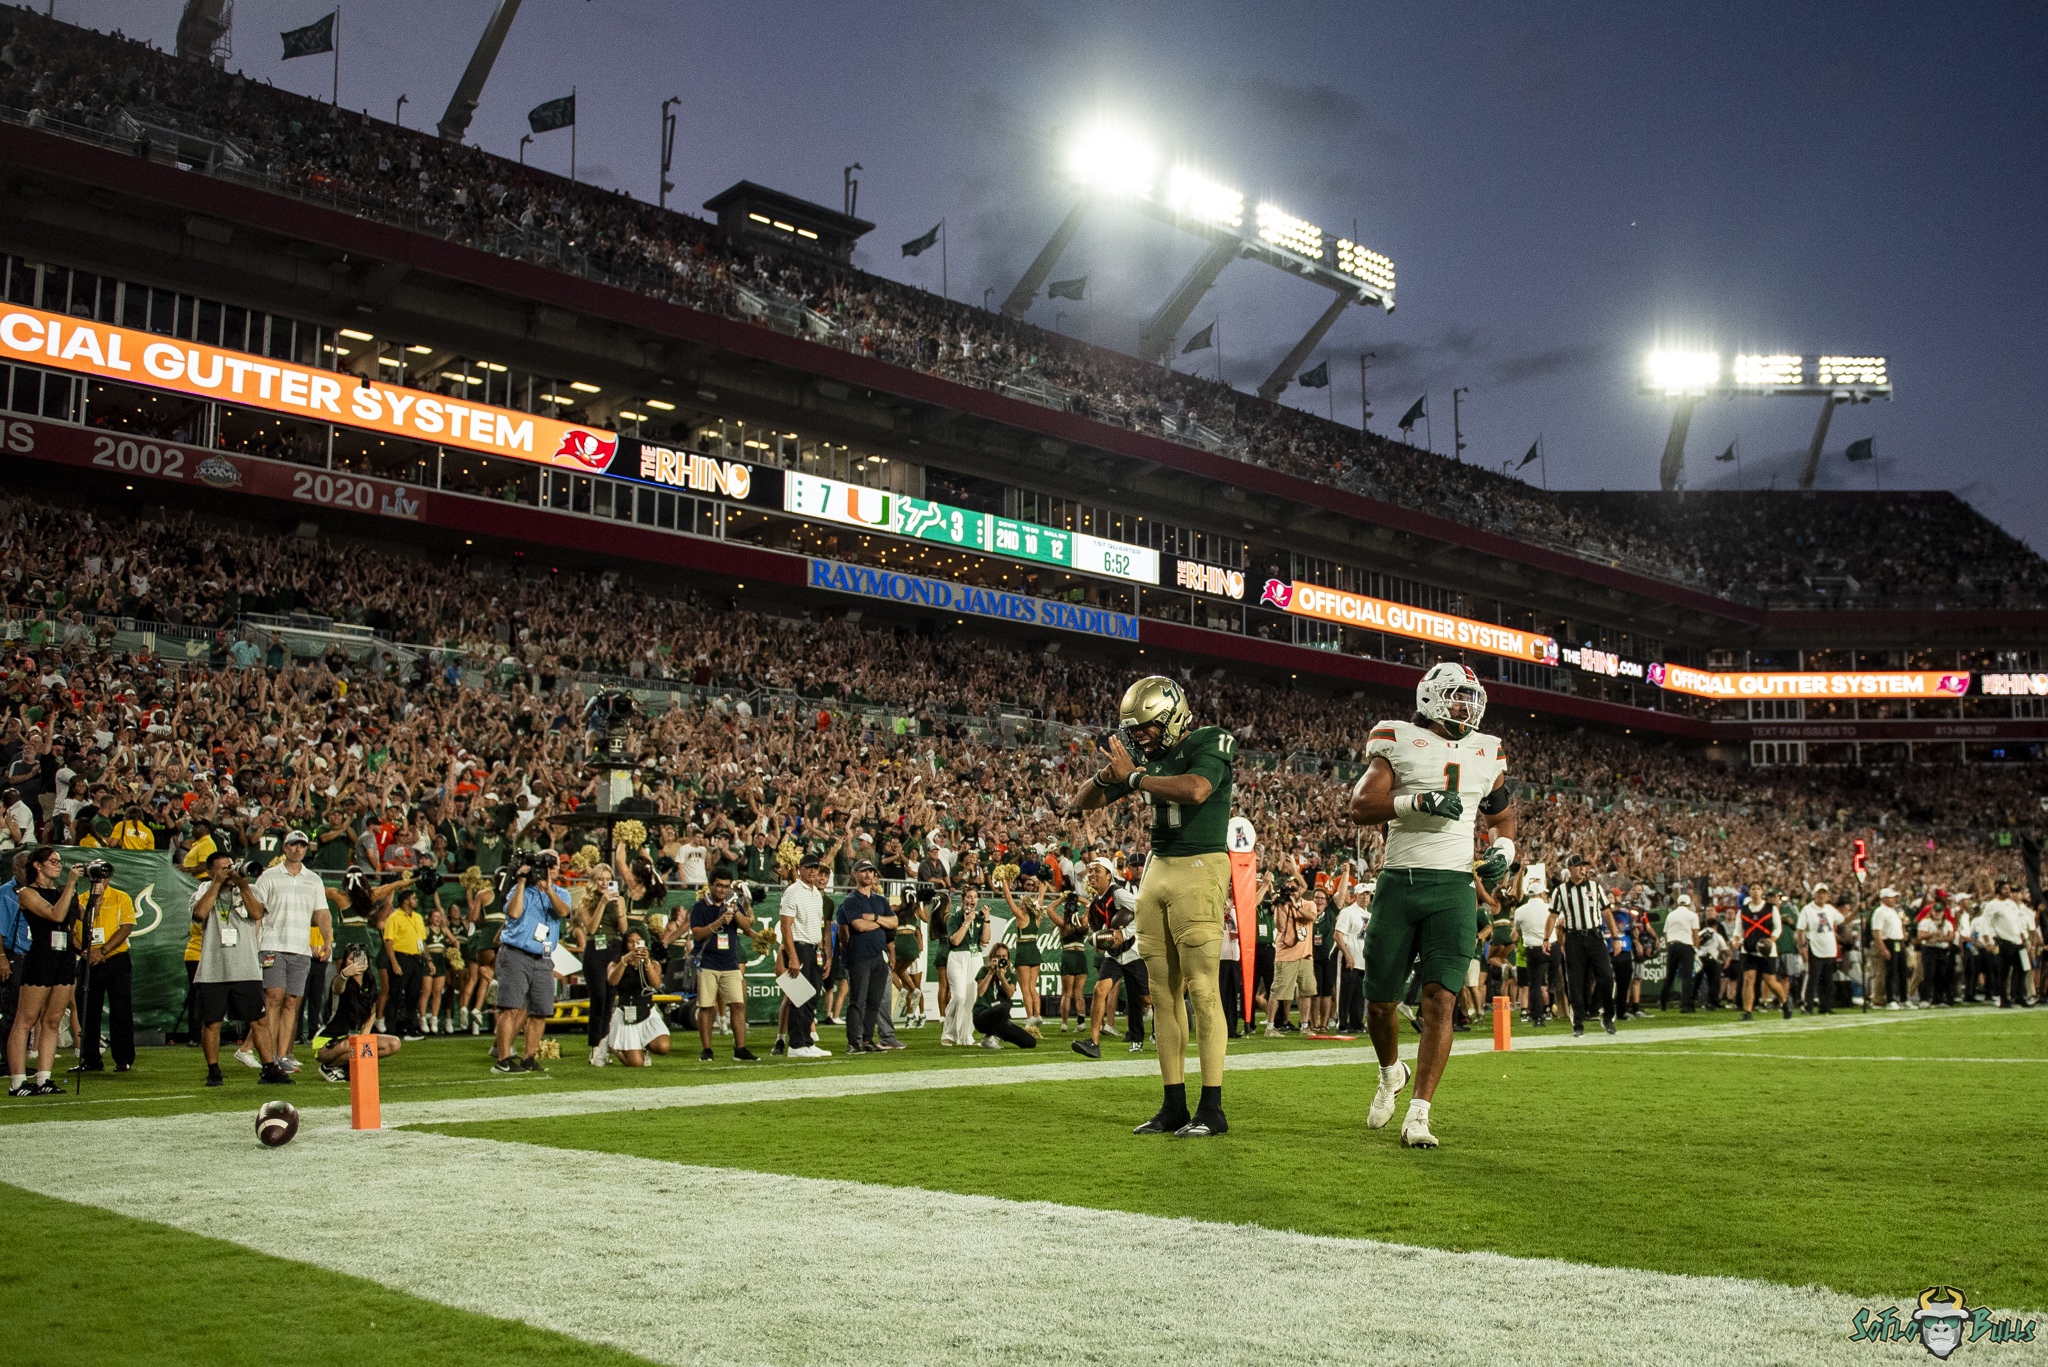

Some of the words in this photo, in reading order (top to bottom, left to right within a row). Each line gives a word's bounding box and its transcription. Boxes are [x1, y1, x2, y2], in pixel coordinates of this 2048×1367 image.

[143, 343, 341, 413] GUTTER
[352, 386, 534, 452] SYSTEM
[93, 436, 185, 478] 2002
[640, 444, 656, 478] THE
[655, 447, 750, 499] RHINO
[293, 471, 374, 510] 2020
[821, 484, 831, 513] 7
[950, 510, 964, 542] 3
[998, 520, 1017, 530] DOWN
[996, 528, 1019, 550] 2ND
[1025, 534, 1037, 554] 10
[1051, 539, 1063, 560] 12
[1093, 540, 1105, 548] 1ST
[1108, 544, 1142, 555] QUARTER
[1104, 552, 1130, 576] 6:52
[1176, 559, 1187, 586] THE
[1186, 561, 1245, 599] RHINO
[812, 559, 952, 608] RAYMOND
[956, 588, 1037, 623] JAMES
[1042, 603, 1139, 640] STADIUM
[1299, 587, 1385, 625] OFFICIAL
[1387, 606, 1455, 640] GUTTER
[1458, 622, 1523, 655] SYSTEM
[1671, 669, 1735, 693] OFFICIAL
[1739, 675, 1828, 694] GUTTER
[1830, 675, 1924, 694] SYSTEM
[1991, 673, 2048, 695] RHINO
[1217, 734, 1235, 753] 17
[1752, 726, 1777, 736] TEXT
[1780, 726, 1800, 736] FAN
[1802, 726, 1839, 737] ISSUES
[1842, 726, 1857, 736] TO
[1444, 762, 1461, 792] 1
[259, 836, 278, 851] 17
[381, 830, 387, 844] 1
[1853, 839, 1866, 873] 2
